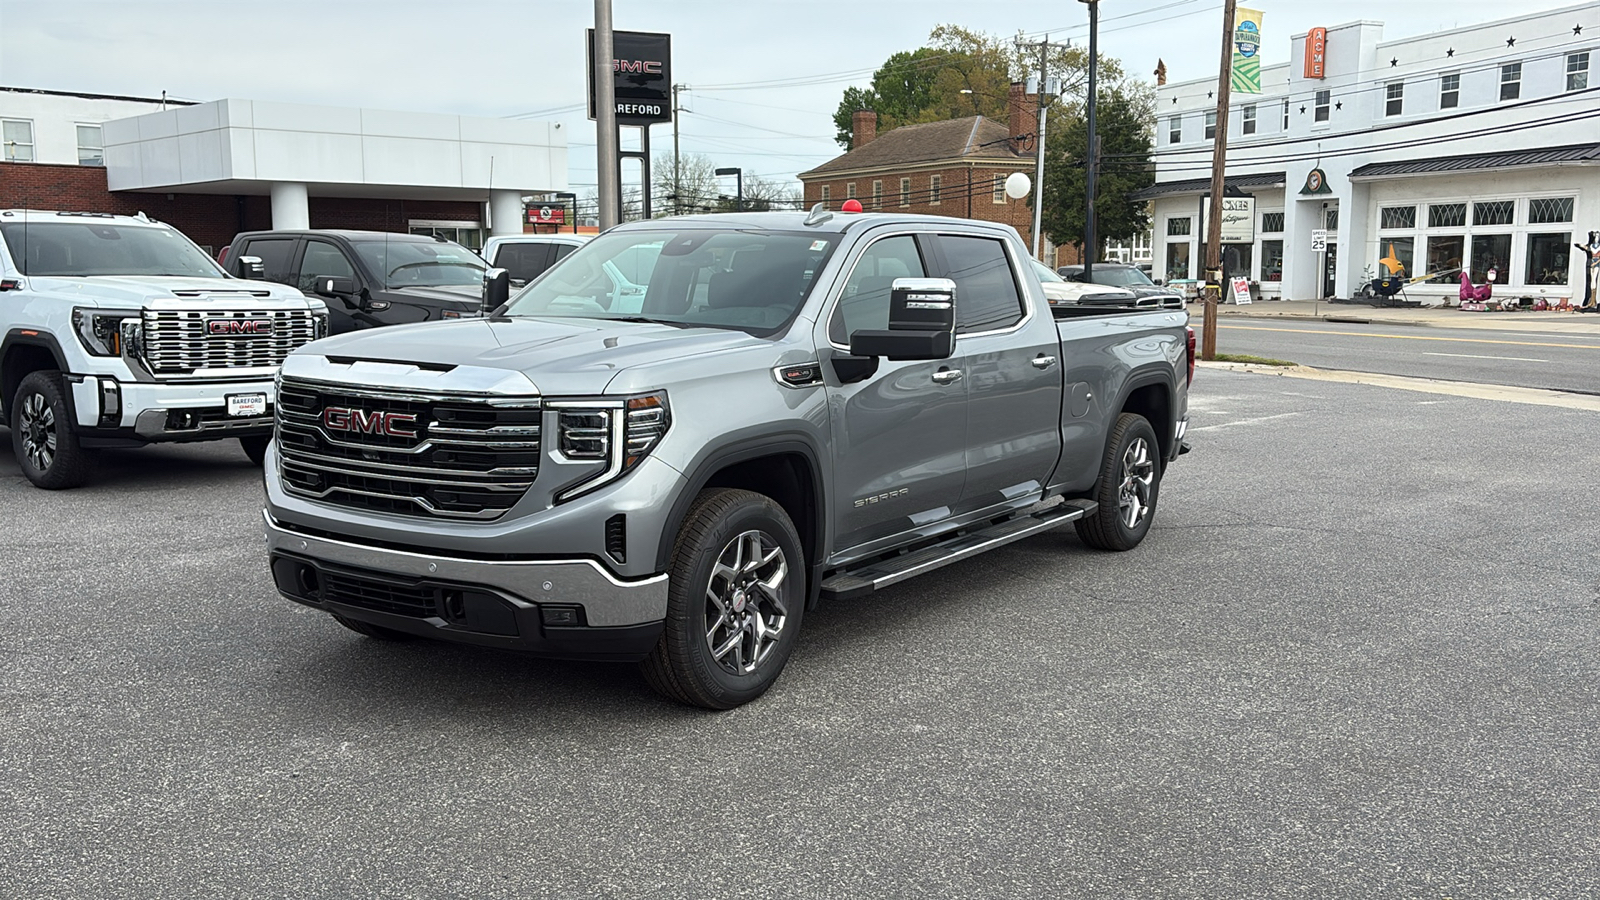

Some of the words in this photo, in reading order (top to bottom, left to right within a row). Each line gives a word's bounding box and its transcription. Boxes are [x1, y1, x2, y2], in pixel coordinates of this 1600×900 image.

[1314, 31, 1323, 75] ACME
[614, 104, 661, 115] REFORD
[1312, 241, 1325, 250] 25
[209, 320, 271, 334] GMC
[324, 406, 418, 439] GMC
[854, 487, 909, 508] SIERRA
